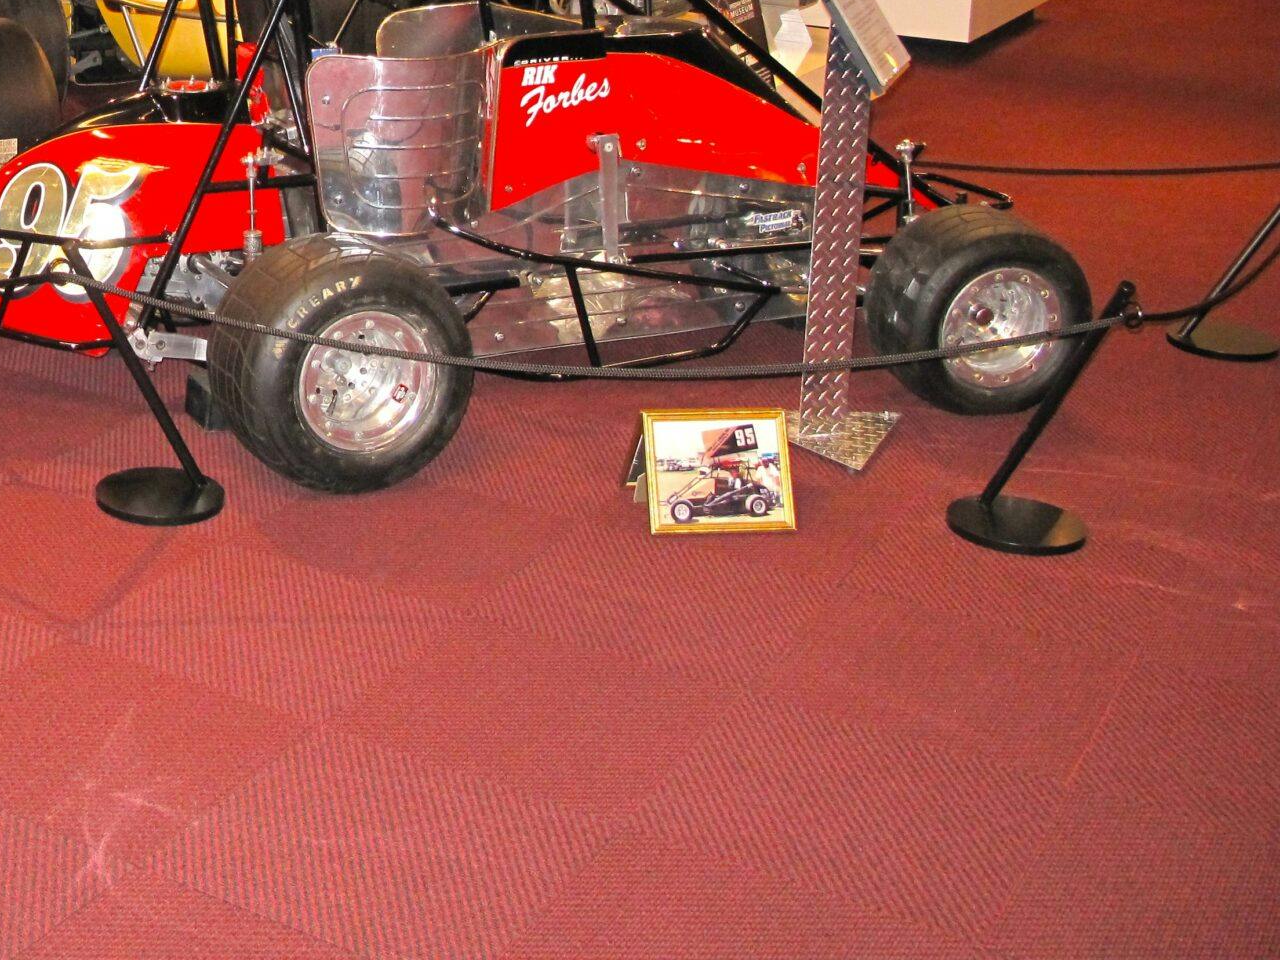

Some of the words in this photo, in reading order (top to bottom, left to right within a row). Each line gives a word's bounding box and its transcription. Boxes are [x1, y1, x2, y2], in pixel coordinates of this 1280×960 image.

[521, 64, 559, 86] RIK
[520, 72, 611, 128] Forbes
[734, 427, 757, 447] 95
